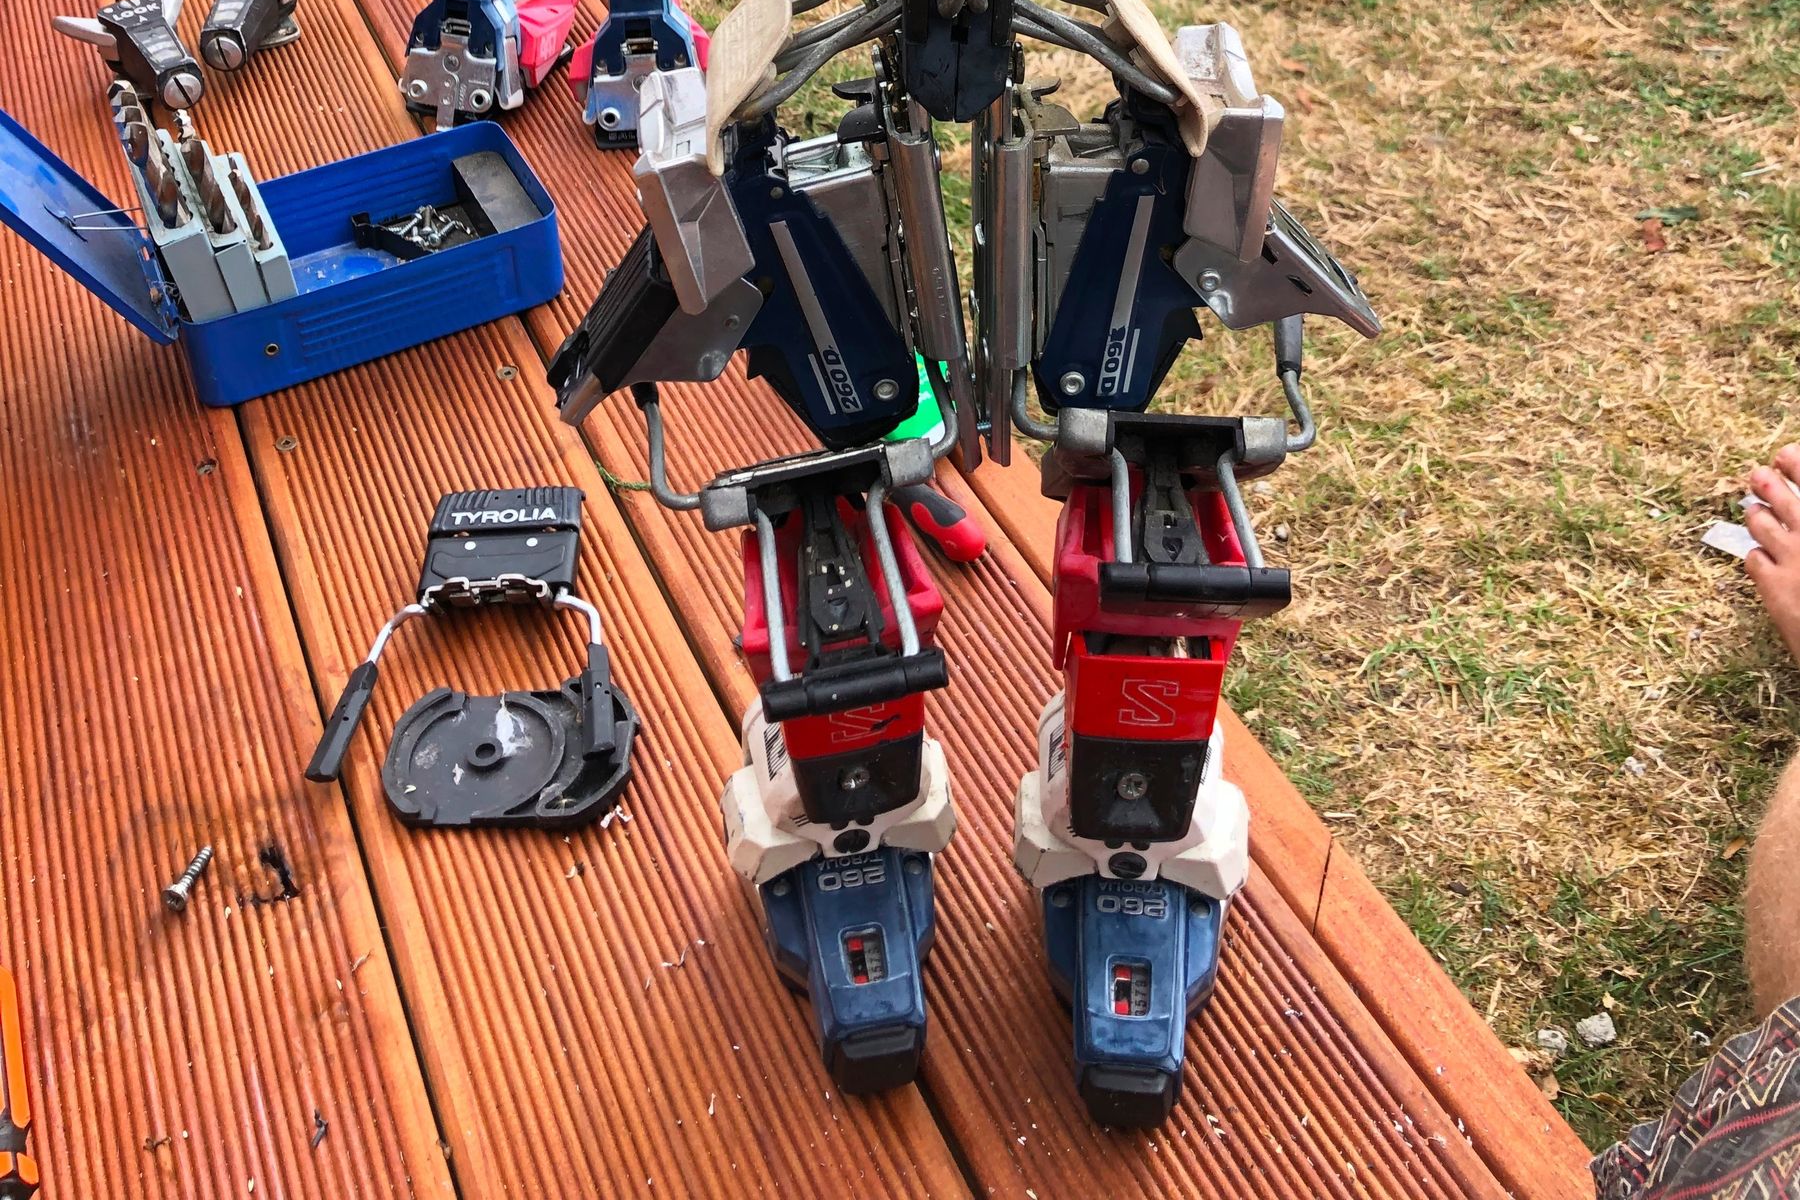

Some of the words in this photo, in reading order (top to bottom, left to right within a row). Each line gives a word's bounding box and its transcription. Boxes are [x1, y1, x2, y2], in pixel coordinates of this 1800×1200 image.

[112, 2, 161, 22] LOOK
[821, 348, 842, 365] D
[829, 367, 861, 410] 260
[1100, 376, 1117, 395] D
[451, 506, 557, 526] TYROLIA
[817, 863, 887, 892] 260
[1096, 894, 1167, 918] 260
